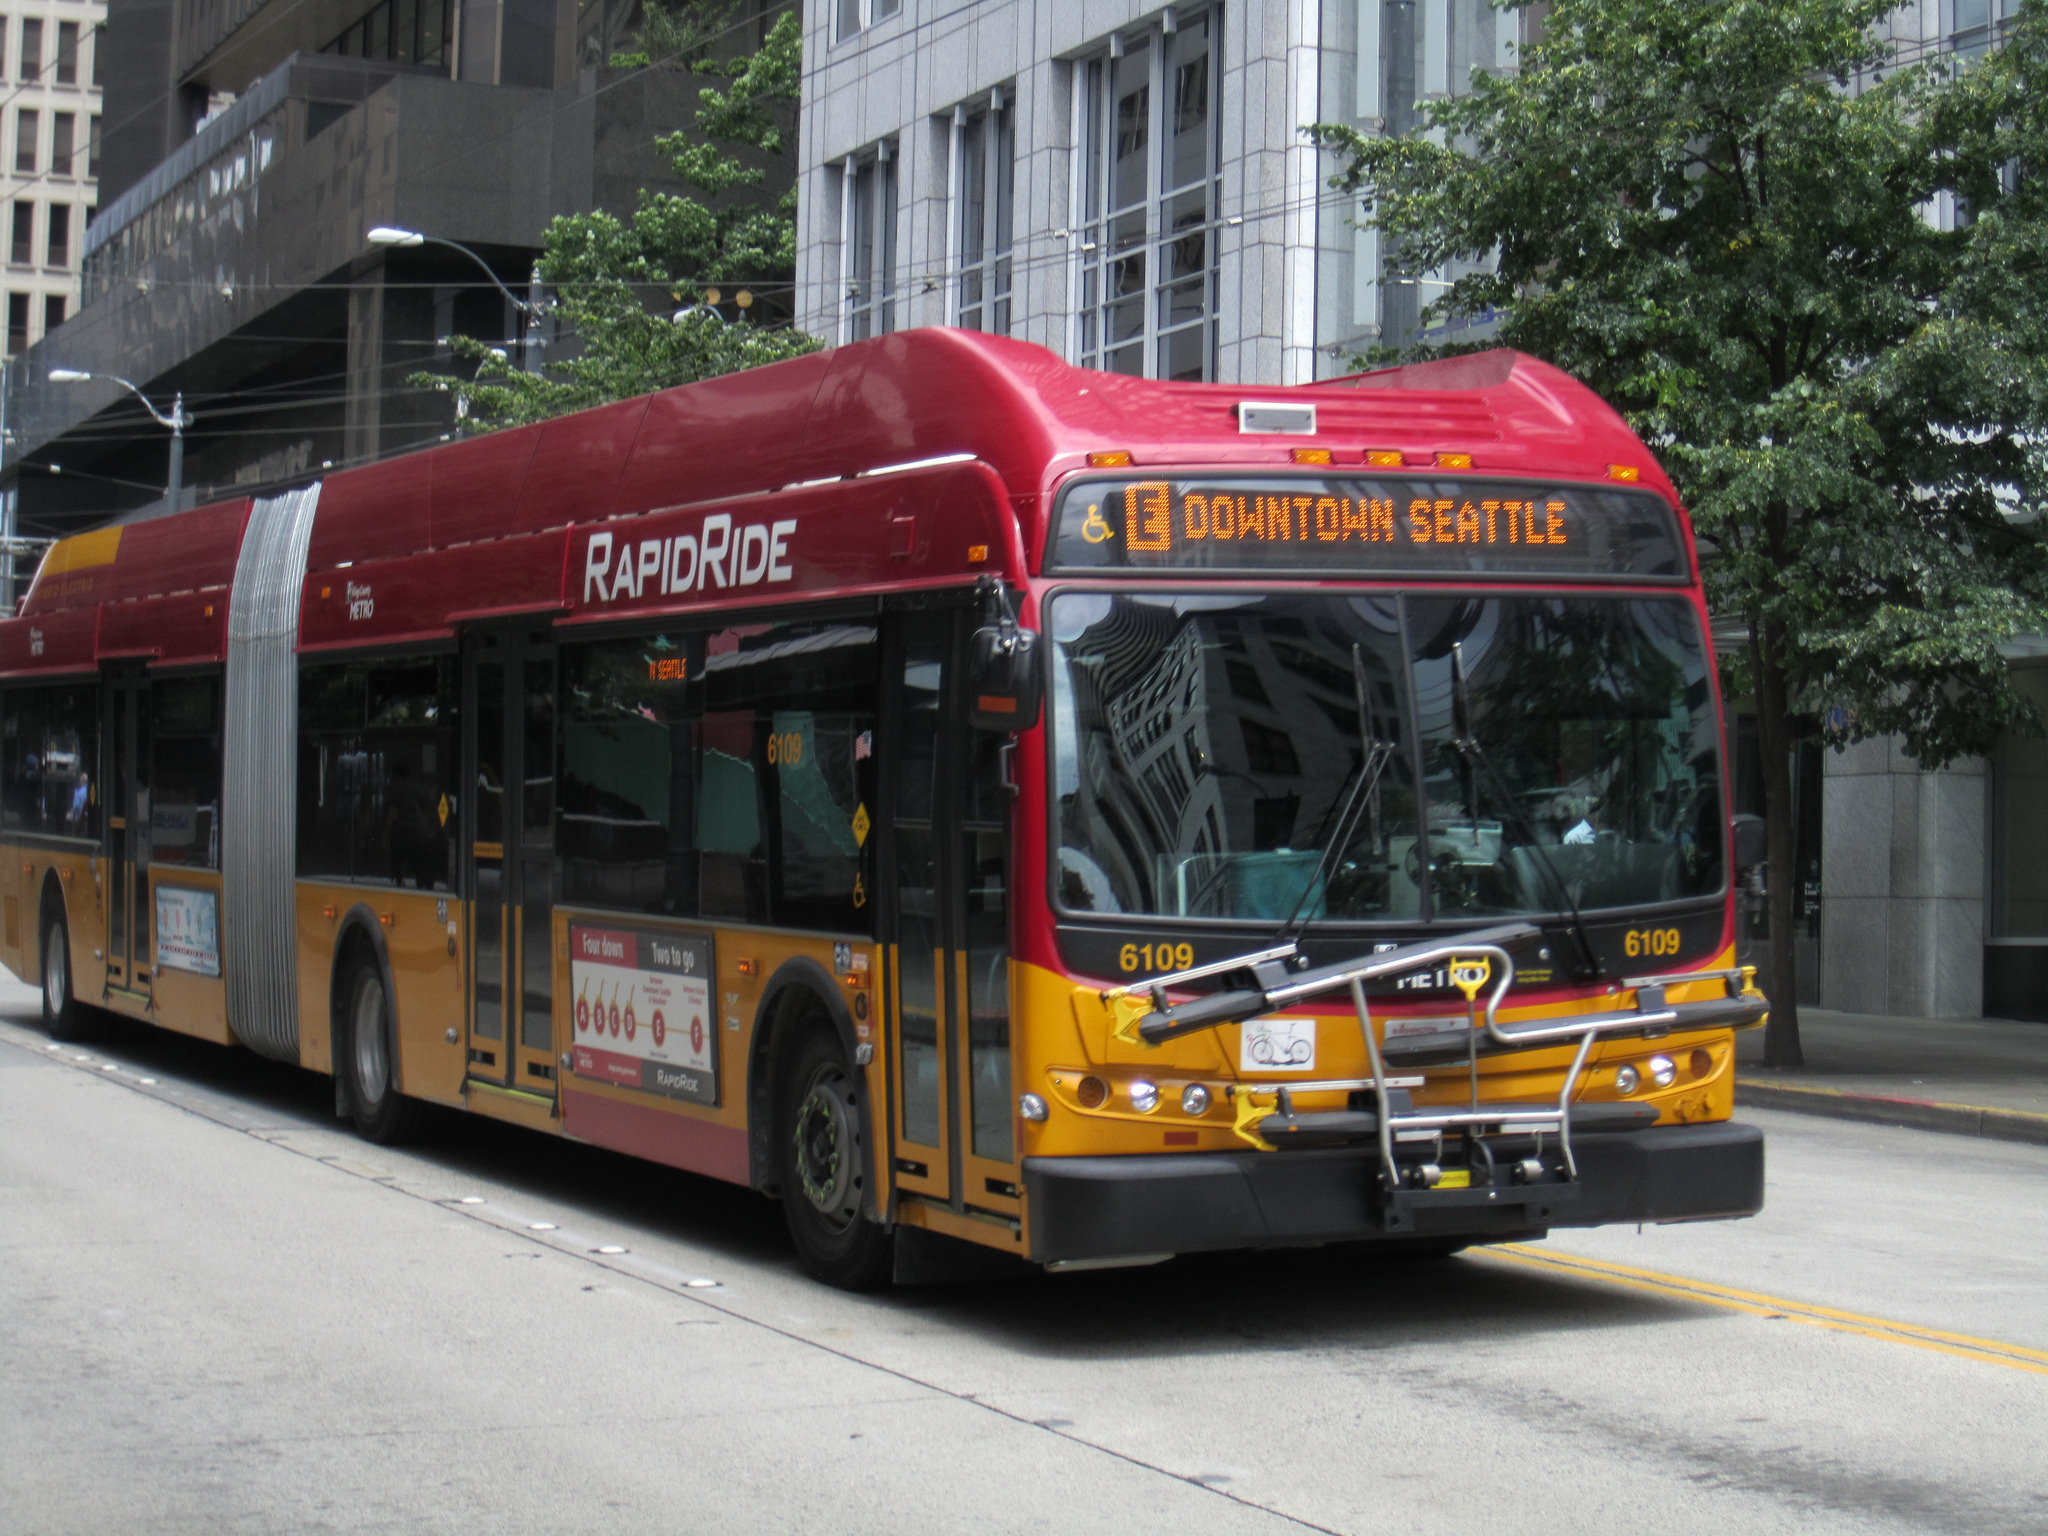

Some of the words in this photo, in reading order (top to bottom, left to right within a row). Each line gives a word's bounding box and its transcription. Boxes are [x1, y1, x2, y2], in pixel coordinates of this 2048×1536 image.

[1185, 495, 1394, 541] DOWNTOWN
[1409, 500, 1567, 546] SEATTLE
[768, 733, 802, 765] 6109
[583, 933, 601, 954] Four
[602, 935, 624, 958] down
[652, 942, 670, 964] Two
[671, 947, 681, 967] to
[683, 952, 695, 974] go
[1119, 943, 1195, 972] 6109
[1624, 929, 1681, 957] 6109
